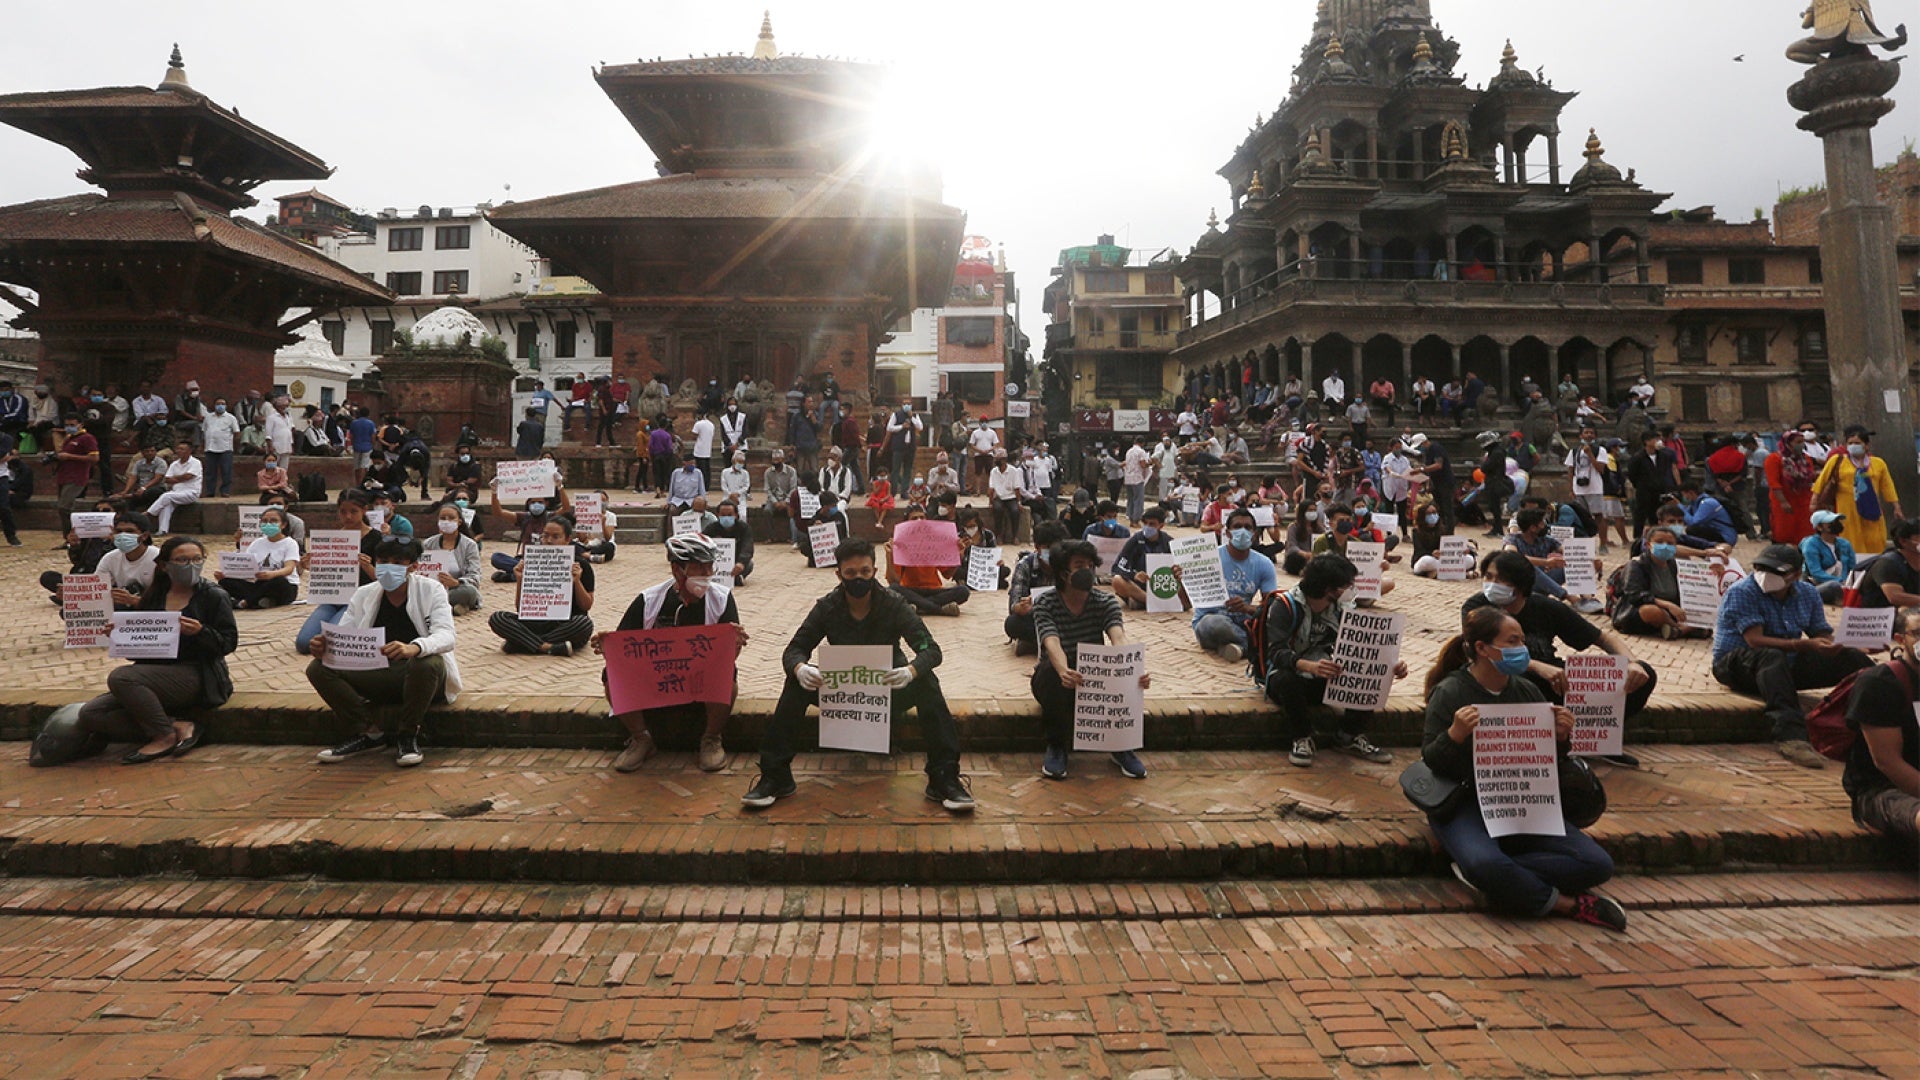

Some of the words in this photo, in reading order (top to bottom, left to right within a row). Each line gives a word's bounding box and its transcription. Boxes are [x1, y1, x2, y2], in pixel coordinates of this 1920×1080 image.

[76, 575, 100, 583] TESTING
[94, 583, 108, 591] FOR
[1153, 582, 1178, 591] PCR
[64, 594, 93, 602] EVERYONE
[95, 593, 103, 601] AT
[66, 611, 104, 619] REGARDLESS
[66, 620, 75, 628] OF
[76, 619, 109, 627] SYMPTOM
[1344, 612, 1392, 630] PROTECT
[67, 629, 75, 637] AS
[77, 628, 93, 636] SOON
[1340, 628, 1399, 645] FRONT-LINE
[67, 637, 96, 646] POSSIBLE
[1337, 642, 1379, 660] HEALTH
[1079, 652, 1100, 663] तारा
[1567, 656, 1583, 667] PCR
[1585, 657, 1616, 667] TESTING
[1079, 665, 1112, 677] कोरोना
[1365, 664, 1388, 675] AND
[1567, 669, 1606, 679] AVAILABLE
[1608, 669, 1623, 680] FOR
[820, 665, 888, 689] सुरक्षित
[1330, 674, 1382, 690] HOSPITAL
[1567, 681, 1606, 692] EVERYONE
[1607, 682, 1616, 692] AT
[1078, 691, 1124, 703] सरकारको
[1327, 688, 1379, 705] WORKERS
[1566, 694, 1587, 704] RISK,
[821, 709, 862, 721] व्यवस्था
[1078, 704, 1105, 716] तयारी
[1076, 718, 1112, 729] जनताले
[1480, 717, 1505, 726] ROVIDE
[1507, 716, 1536, 726] LEGALLY
[1575, 718, 1619, 728] SYMPTOMS,
[1476, 730, 1506, 740] BINDING
[1507, 729, 1552, 739] PROTECTION
[1575, 729, 1596, 740] SOON
[1598, 729, 1608, 740] AS
[1476, 743, 1507, 753] AGAINST
[1508, 742, 1536, 752] STIGMA
[1476, 756, 1491, 765] AND
[1492, 755, 1554, 765] DISCRIMINATION
[1477, 769, 1491, 779] FOR
[1492, 769, 1520, 778] ANYONE
[1522, 768, 1540, 778] WHO
[1541, 768, 1550, 778] IS
[1478, 782, 1518, 792] SUSPECTED
[1519, 781, 1530, 791] OR
[1481, 796, 1520, 806] CONFIRMED
[1521, 795, 1555, 805] POSITIVE
[1484, 809, 1494, 819] FOR
